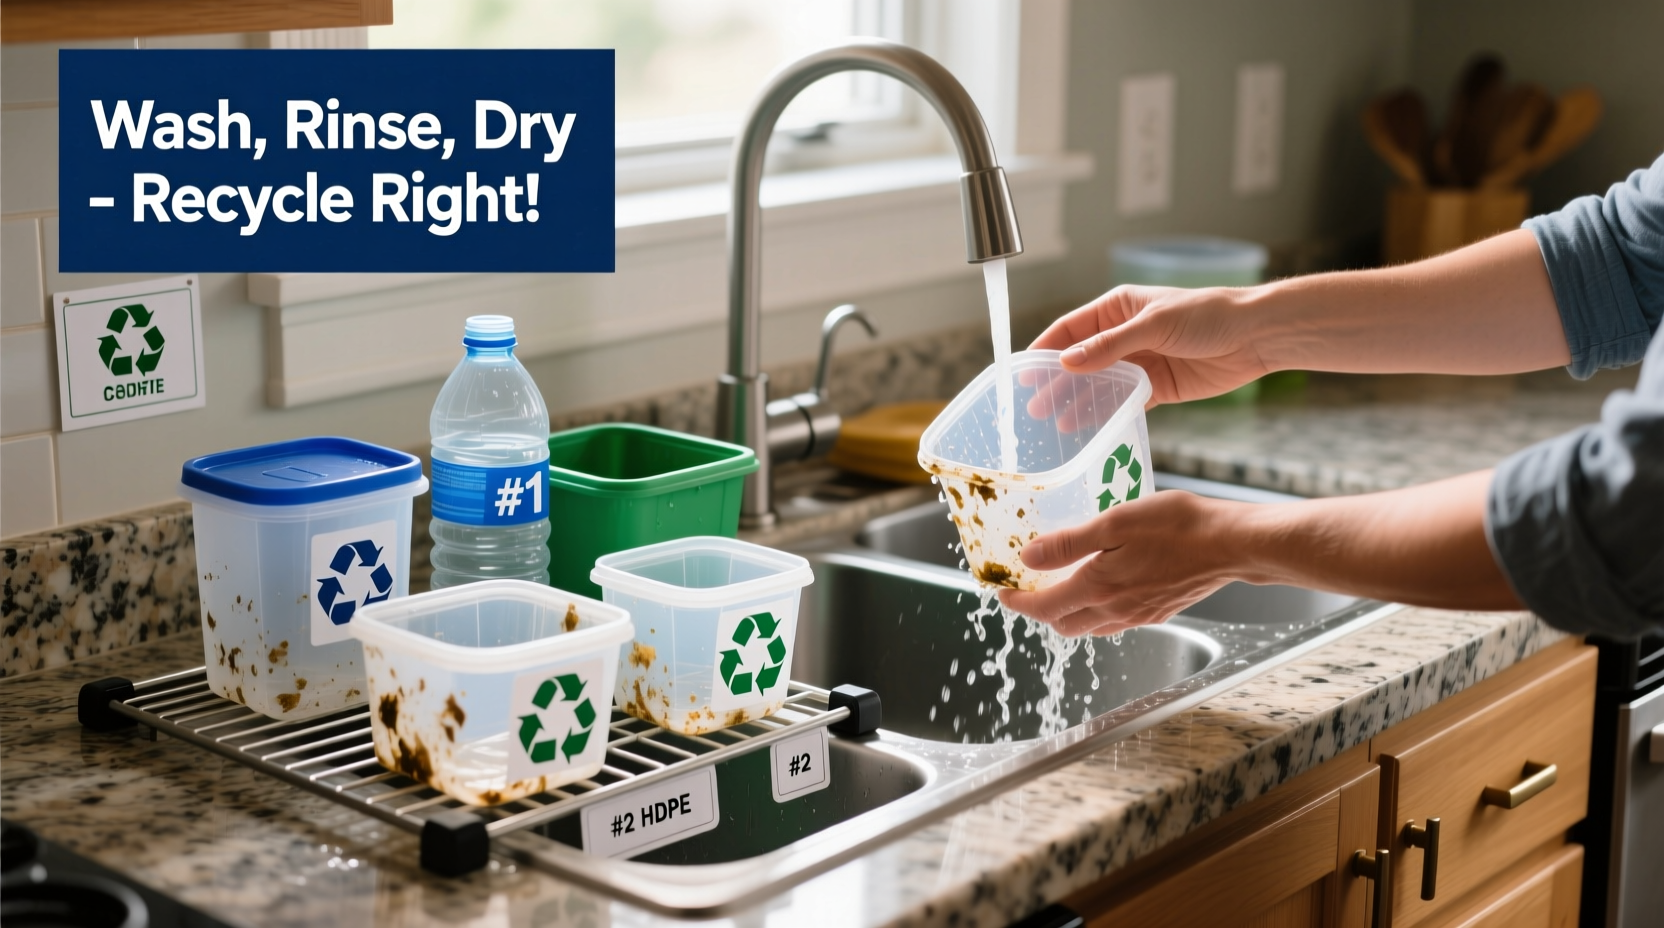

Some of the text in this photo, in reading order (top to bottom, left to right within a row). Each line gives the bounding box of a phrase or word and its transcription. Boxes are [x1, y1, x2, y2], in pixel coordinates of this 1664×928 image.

[494, 470, 542, 517] #1
[788, 752, 812, 777] #2
[610, 793, 692, 838] #2 HDPE
